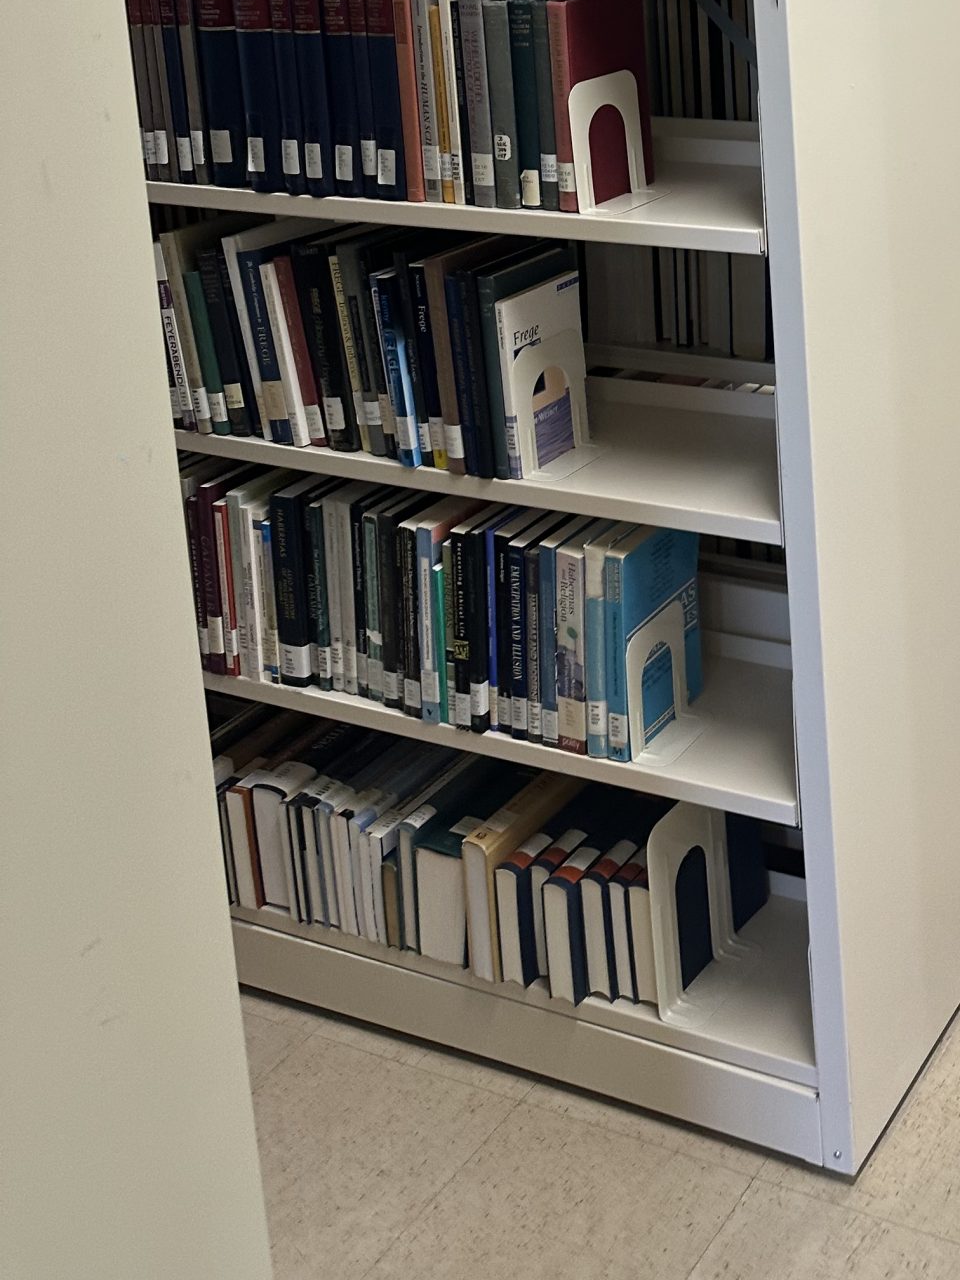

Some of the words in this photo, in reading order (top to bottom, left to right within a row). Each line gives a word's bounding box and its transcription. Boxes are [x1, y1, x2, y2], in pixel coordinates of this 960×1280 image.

[415, 25, 425, 62] Introduction
[420, 81, 430, 123] HUMAN
[331, 261, 344, 298] FREGE
[338, 301, 350, 334] Tradition
[416, 304, 429, 333] Frege
[164, 316, 184, 386] FEYERABEND
[513, 324, 540, 346] Frege
[275, 509, 288, 558] HABERMAS
[197, 534, 217, 610] GADAMER
[453, 543, 464, 585] Recovering
[456, 590, 465, 617] Ethical
[508, 565, 522, 619] EMANCIPATION
[557, 579, 570, 622] Religion
[565, 562, 579, 614] Habermas
[510, 623, 521, 639] AND
[526, 594, 539, 639] HABERMAS
[510, 643, 523, 679] ILLUSION
[528, 640, 538, 658] AND
